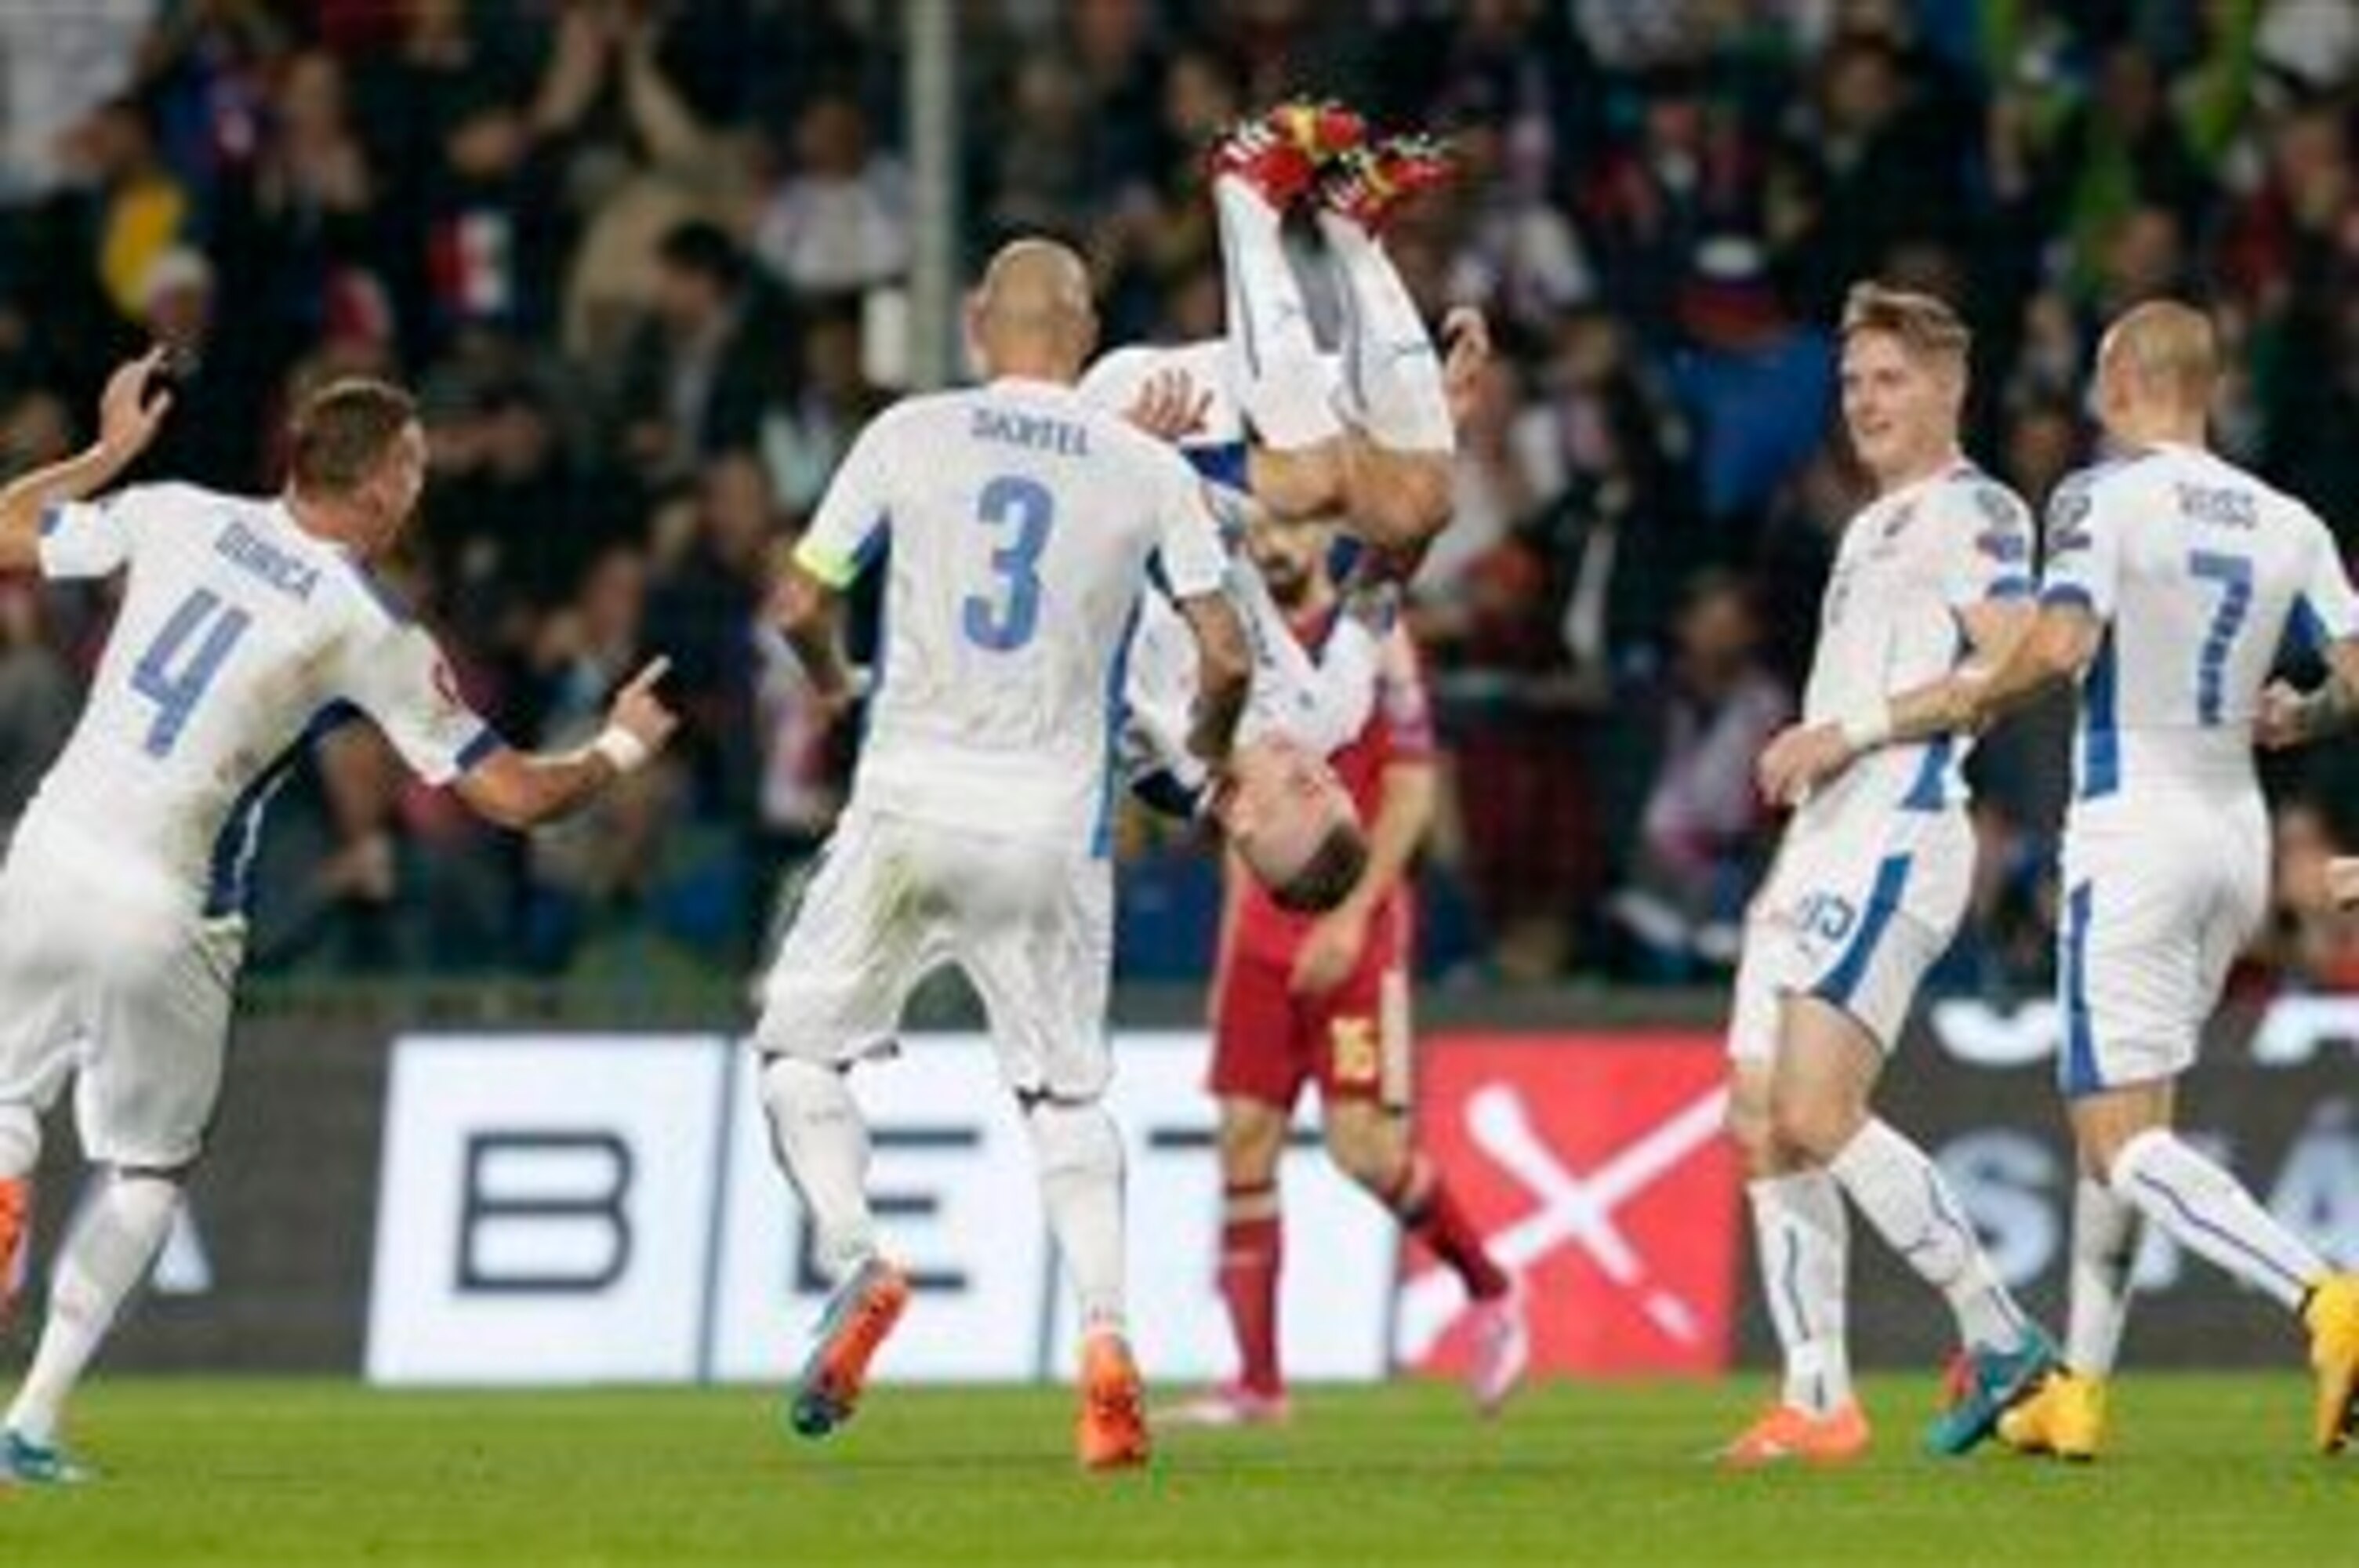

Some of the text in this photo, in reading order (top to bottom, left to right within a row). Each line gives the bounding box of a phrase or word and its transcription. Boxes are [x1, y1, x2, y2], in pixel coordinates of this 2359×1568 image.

[964, 475, 1055, 652] 3
[2187, 550, 2256, 728] 7
[129, 588, 251, 759] 4
